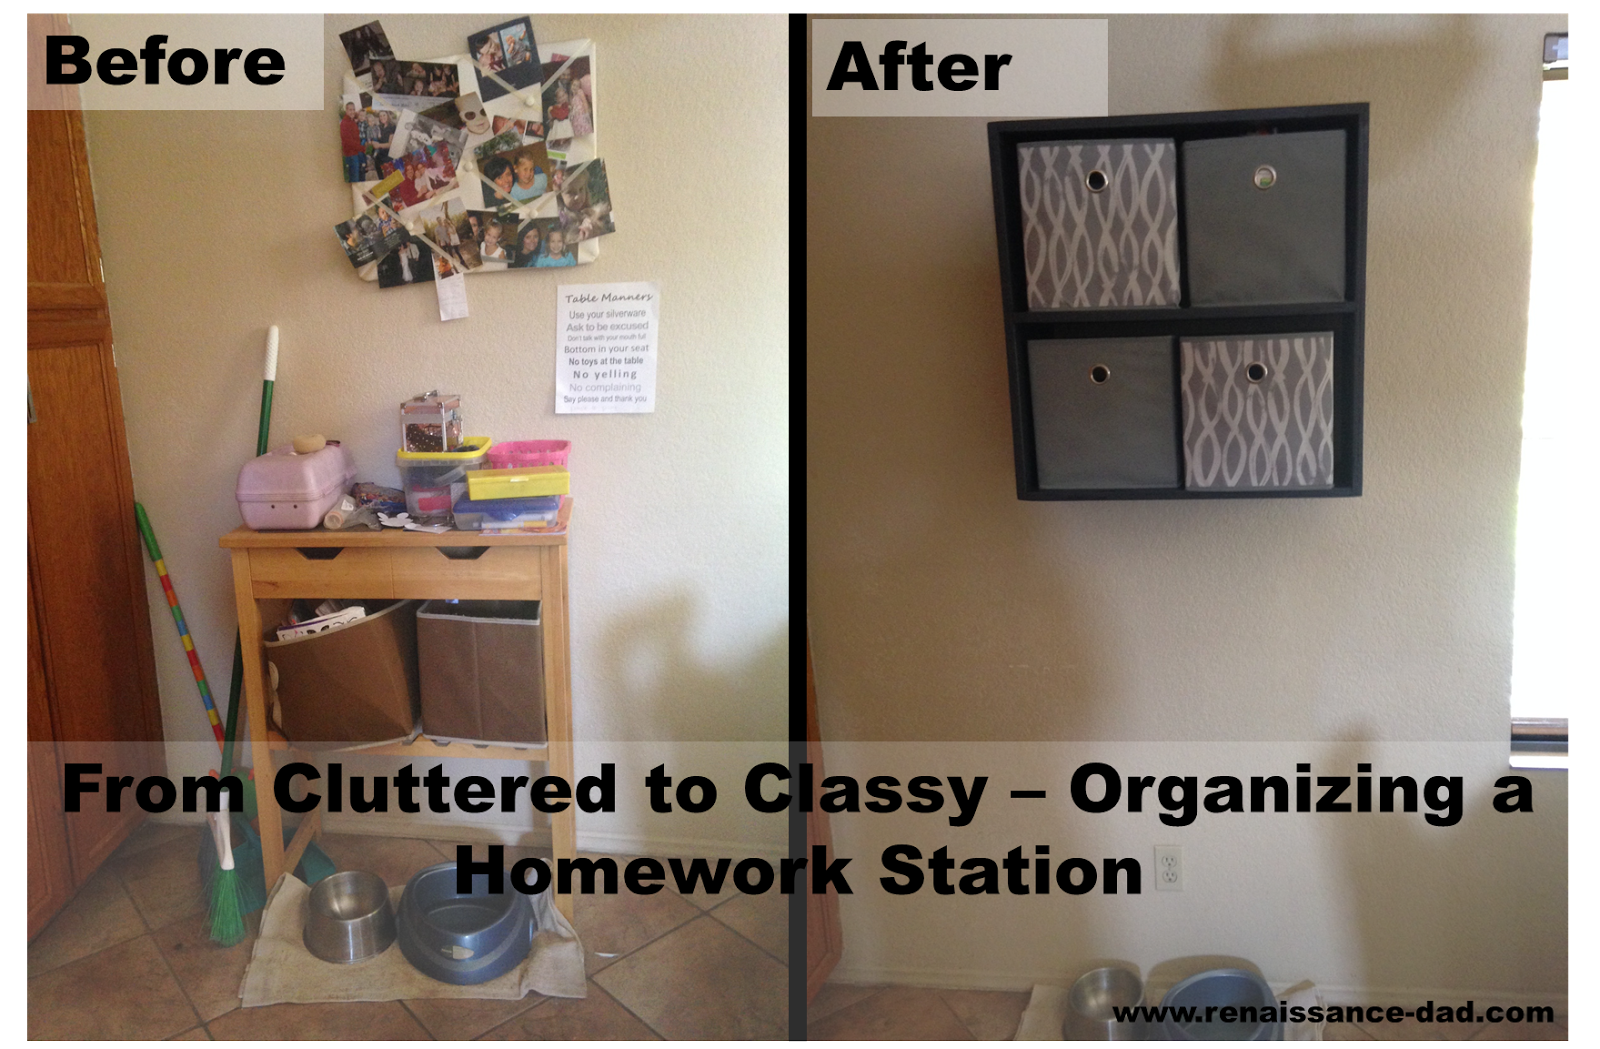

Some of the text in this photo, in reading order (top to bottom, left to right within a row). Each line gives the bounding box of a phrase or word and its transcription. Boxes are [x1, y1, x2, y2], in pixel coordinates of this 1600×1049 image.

[565, 292, 653, 303] Table Manners
[569, 309, 646, 320] Use your silverware
[566, 321, 649, 332] Ask to be excused
[564, 345, 596, 353] Bottom
[609, 345, 629, 354] your
[631, 344, 649, 352] seat
[569, 357, 580, 365] No
[582, 357, 598, 367] toys
[600, 357, 607, 365] at
[624, 356, 643, 364] table
[573, 369, 637, 380] No yelling
[569, 382, 641, 393] No complaining
[564, 395, 576, 404] Say
[578, 395, 599, 403] please
